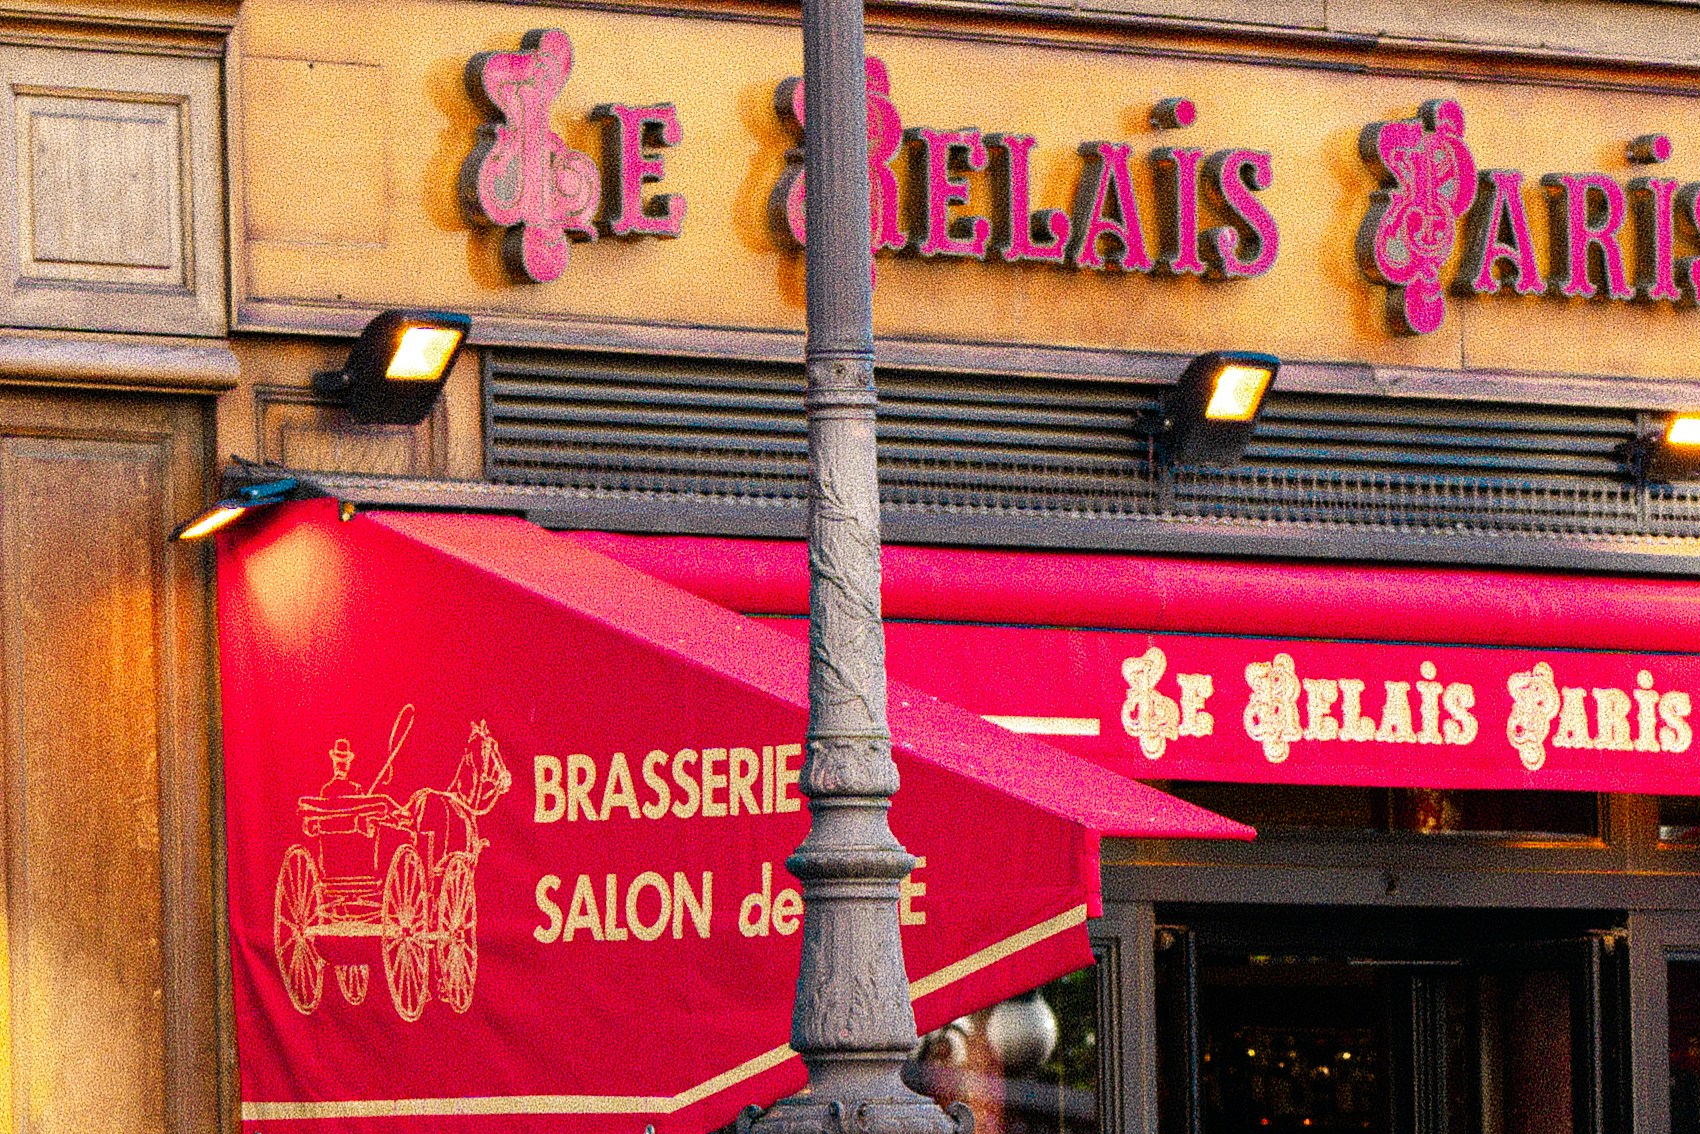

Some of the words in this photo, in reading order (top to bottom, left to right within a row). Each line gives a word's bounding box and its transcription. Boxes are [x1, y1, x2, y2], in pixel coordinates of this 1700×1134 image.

[462, 28, 687, 284] LE
[1120, 646, 1214, 761] LE
[1243, 652, 1479, 764] RELAIS
[1507, 661, 1694, 773] PARIS
[532, 742, 804, 824] BRASSERIE
[533, 871, 713, 944] SALON
[738, 862, 804, 938] de
